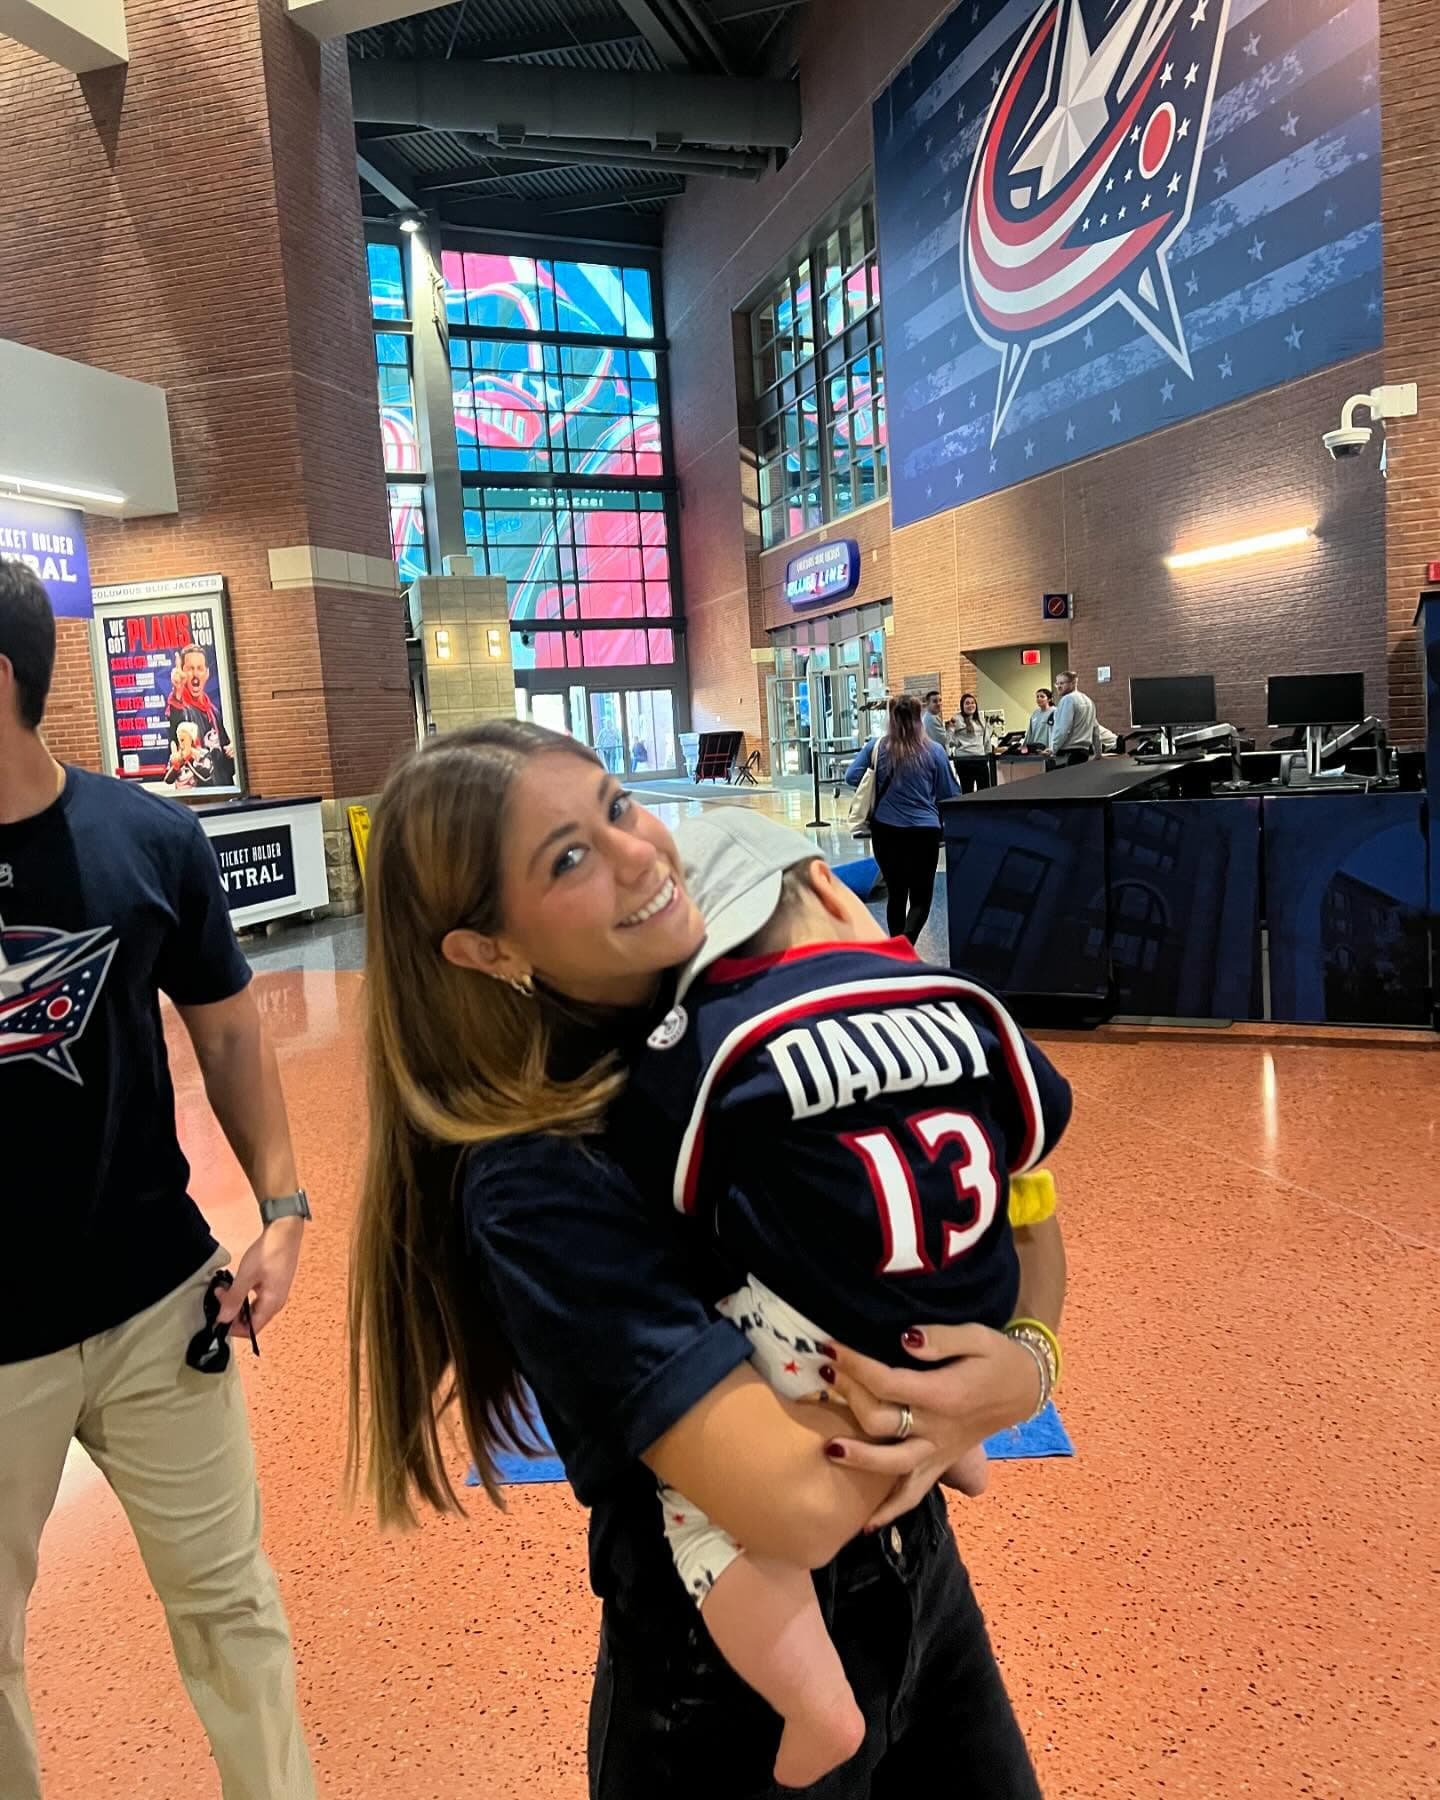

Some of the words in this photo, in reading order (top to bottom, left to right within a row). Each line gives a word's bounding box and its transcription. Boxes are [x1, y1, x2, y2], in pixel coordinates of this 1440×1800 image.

[32, 532, 75, 556] HOLDER
[109, 619, 125, 637] WE
[190, 611, 210, 630] FOR
[107, 636, 126, 654] GOT
[127, 613, 191, 653] PLANS
[192, 628, 213, 646] YOU
[219, 848, 249, 868] TICKET
[251, 842, 282, 862] HOLDER
[765, 1001, 990, 1121] DADDY
[836, 1106, 999, 1277] 13
